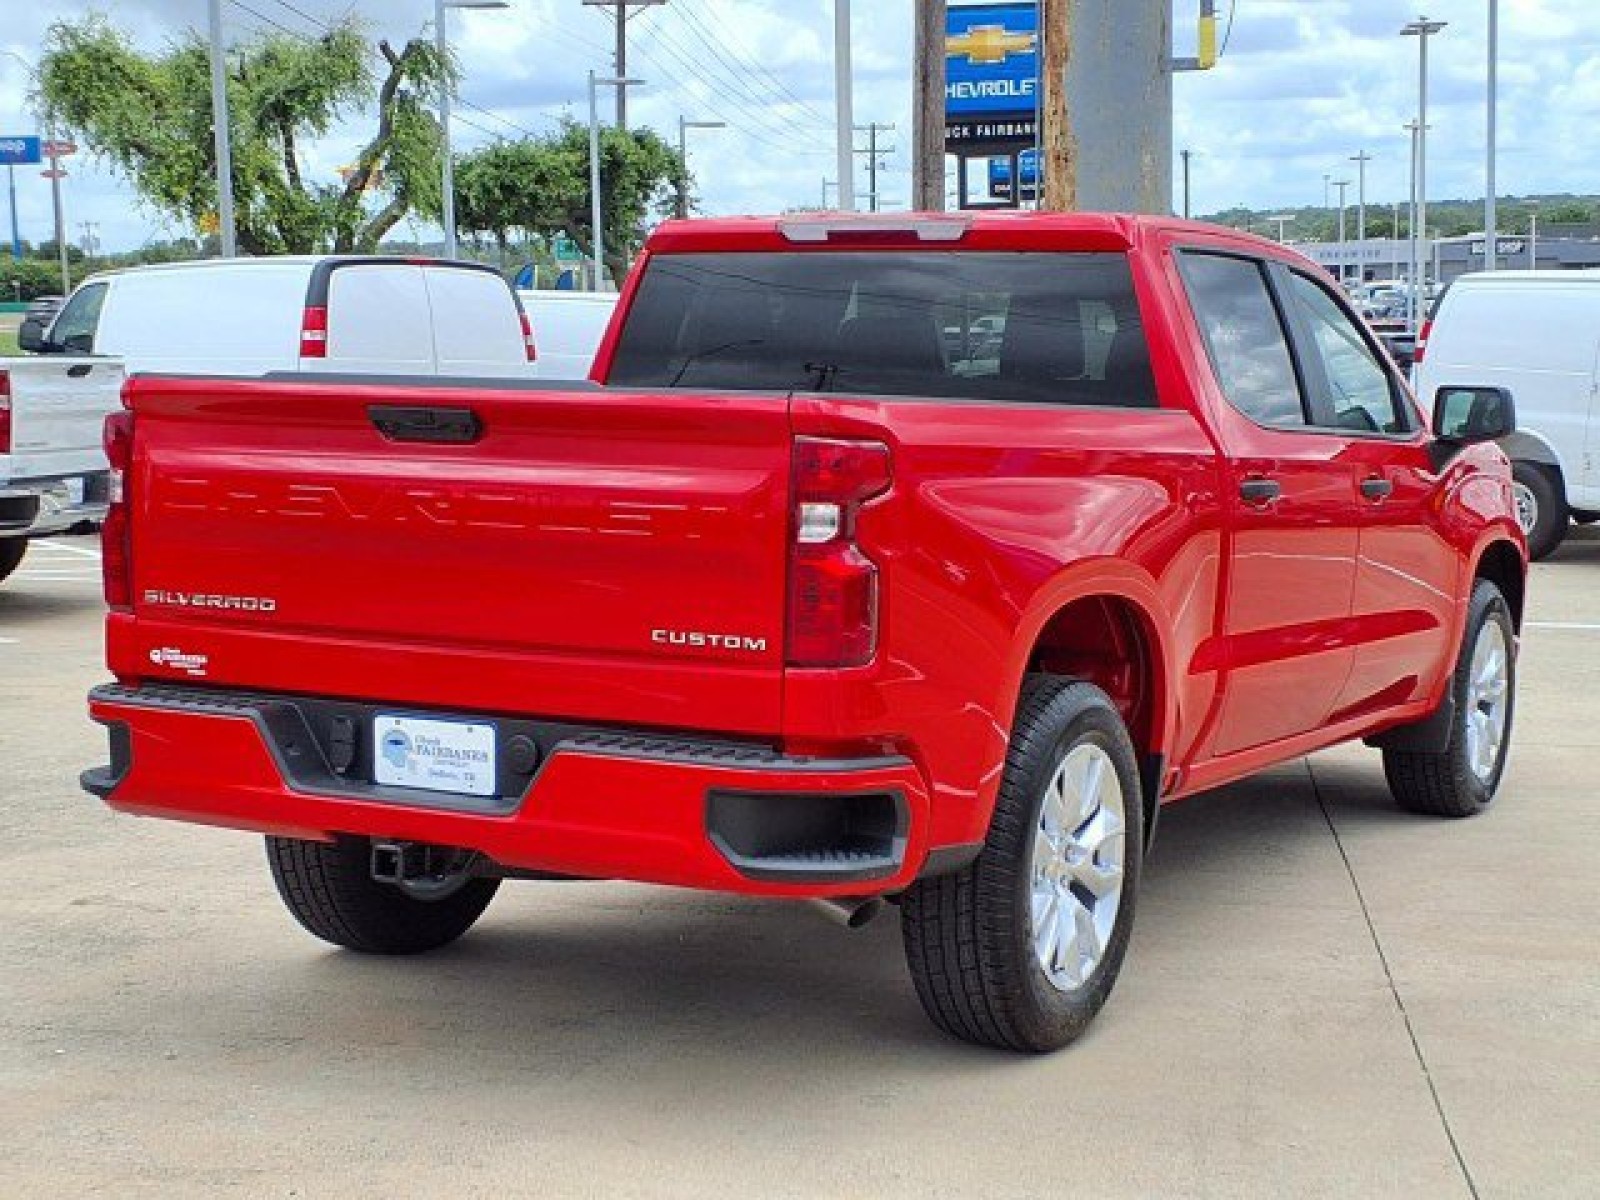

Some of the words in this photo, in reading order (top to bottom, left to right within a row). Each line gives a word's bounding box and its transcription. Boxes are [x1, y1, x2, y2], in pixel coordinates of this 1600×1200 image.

[945, 78, 1037, 98] HEVROLE
[145, 589, 276, 611] SILVERADO
[651, 629, 766, 651] CUSTOM
